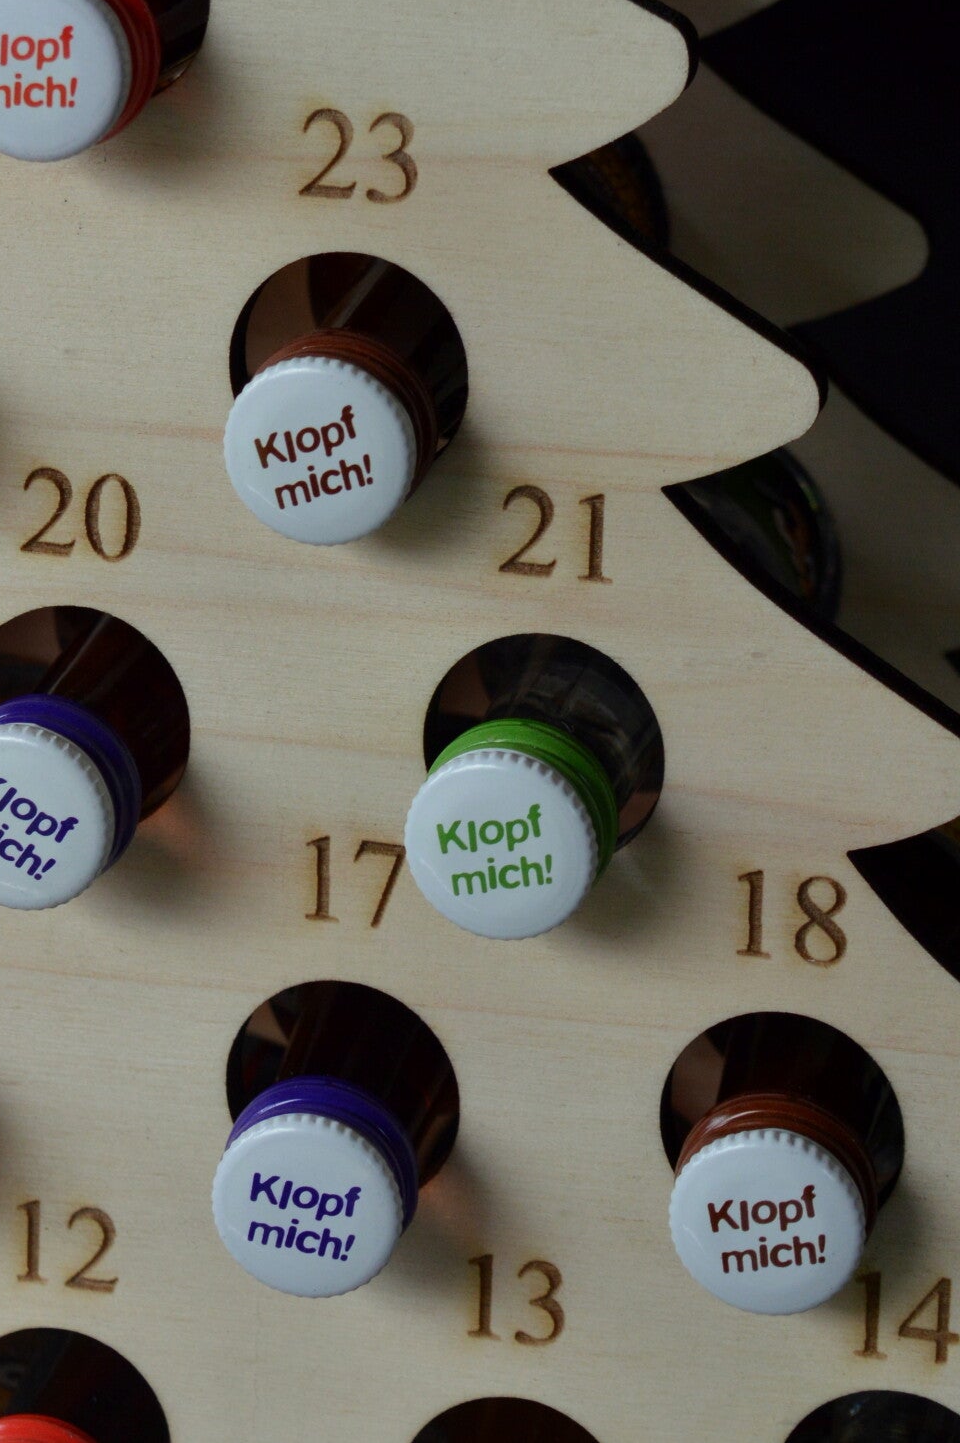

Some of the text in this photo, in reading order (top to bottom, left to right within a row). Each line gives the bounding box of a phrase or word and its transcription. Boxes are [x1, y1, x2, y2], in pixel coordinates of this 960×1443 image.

[298, 107, 419, 205] 23
[253, 404, 358, 468] Klopf
[19, 467, 141, 562] 20
[274, 453, 375, 510] mich!
[498, 484, 613, 584] 21
[436, 802, 543, 855] Klopf
[306, 835, 406, 928] 17
[450, 854, 554, 898] mich!
[737, 869, 849, 967] 18
[250, 1171, 362, 1223] Klopf
[707, 1183, 817, 1233] Klopf
[16, 1199, 119, 1292] 12
[247, 1218, 356, 1261] mich!
[721, 1234, 827, 1273] mich!
[467, 1253, 566, 1346] 13
[854, 1271, 960, 1364] 14
